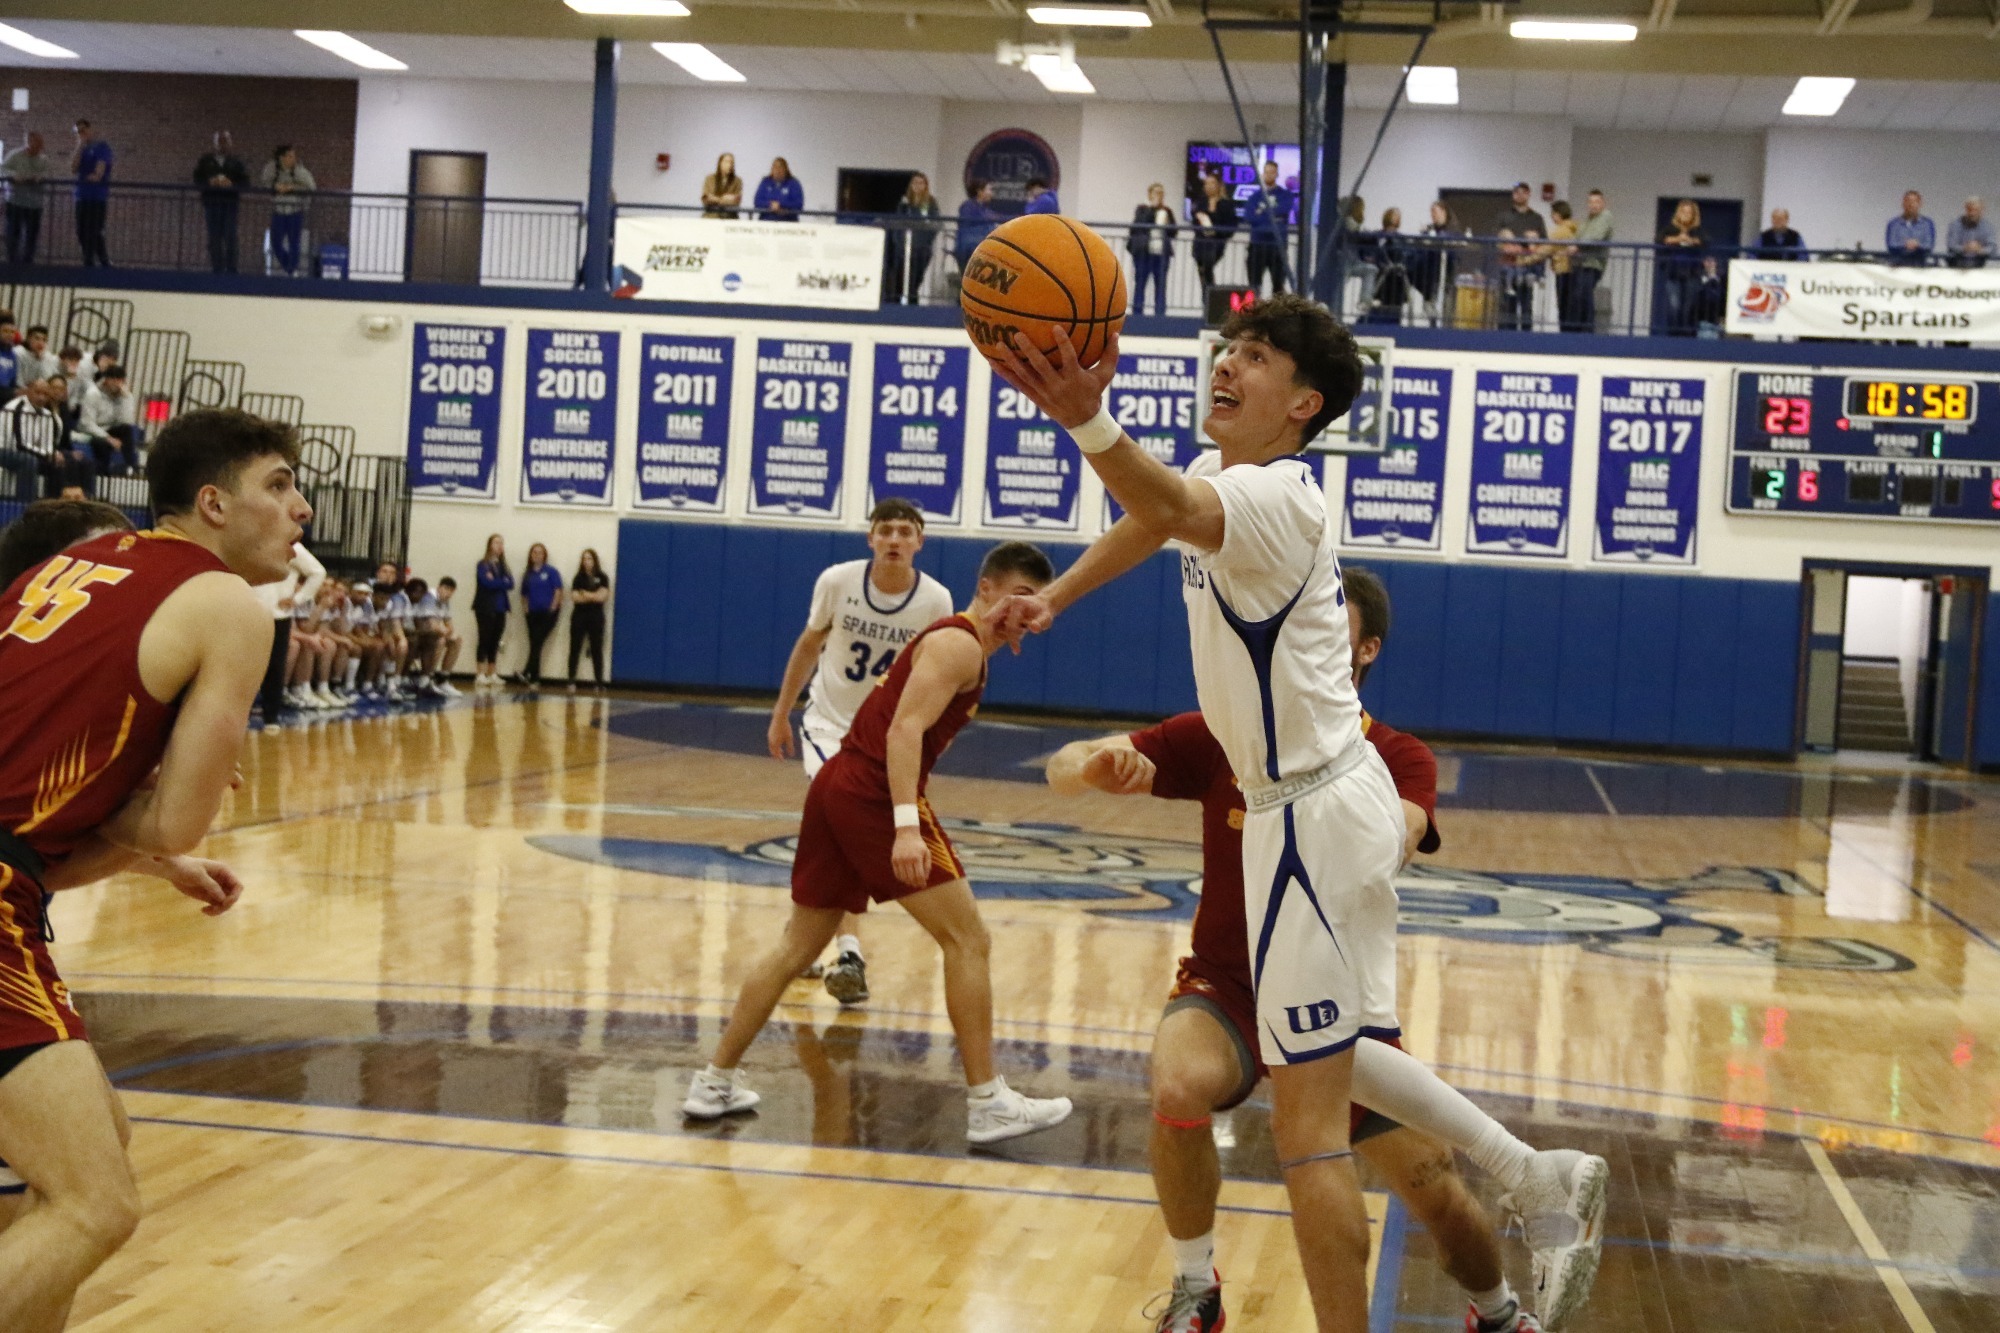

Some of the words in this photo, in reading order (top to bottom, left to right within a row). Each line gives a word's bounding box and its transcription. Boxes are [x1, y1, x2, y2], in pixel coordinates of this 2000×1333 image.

[651, 244, 710, 255] AMERICAN
[1801, 279, 1897, 301] University
[1902, 284, 1922, 298] of
[1841, 302, 1971, 332] Spartans
[426, 327, 495, 345] WOMEN'S
[552, 333, 599, 348] MEN'S
[429, 342, 487, 360] SOCCER
[544, 348, 603, 364] SOCCER
[650, 344, 723, 364] FOOTBALL
[783, 343, 829, 359] MEN'S
[898, 348, 946, 364] MEN'S
[758, 357, 848, 377] BASKETBALL
[901, 364, 940, 380] GOLF
[1137, 358, 1185, 375] MEN'S
[419, 362, 495, 396] 2009
[537, 368, 606, 400] 2010
[653, 372, 717, 406] 2011
[1111, 373, 1197, 391] BASKETBAL
[1501, 375, 1552, 392] MEN'S
[1629, 380, 1681, 398] MEN'S
[1758, 375, 1813, 396] HOME
[763, 378, 840, 412] 2013
[880, 384, 958, 417] 2014
[1476, 390, 1574, 410] BASKETBALL
[1867, 382, 1967, 419] 10:58
[1117, 394, 1194, 428] 2015
[1602, 396, 1647, 414] TRACK
[1665, 398, 1703, 416] FIELD
[1766, 397, 1811, 435] 23
[423, 426, 482, 443] CONFERENCE
[1482, 409, 1566, 445] 2016
[1608, 418, 1693, 454] 2017
[421, 442, 483, 460] TOURNAMENT
[529, 438, 608, 459] CONFERENCE
[1770, 436, 1811, 451] BONUS
[1874, 434, 1919, 448] PERIOD
[1932, 430, 1942, 458] 1
[642, 442, 721, 465] CONFERENCE
[767, 446, 828, 463] CONFERENCE
[885, 452, 947, 469] CONFERENCE
[422, 460, 479, 477] CHAMPIONS
[530, 460, 605, 480] CHAMPIONS
[995, 455, 1058, 473] CONFERENCE
[1844, 460, 1889, 475] PLAYER
[1895, 462, 1938, 477] POINTS
[1943, 464, 1980, 479] FOULS
[642, 465, 718, 487] CHAMPIONS
[885, 468, 945, 486] CHAMPIONS
[1766, 469, 1786, 499] 2
[1798, 470, 1818, 501] 6
[1352, 477, 1437, 501] CONFERENCE
[1476, 483, 1563, 507] CONFERENCE
[1352, 500, 1433, 523] CHAMPIONS
[1476, 506, 1560, 529] CHAMPIONS
[842, 615, 917, 643] SPARTANS
[845, 641, 896, 682] 34
[1284, 999, 1340, 1034] UD
